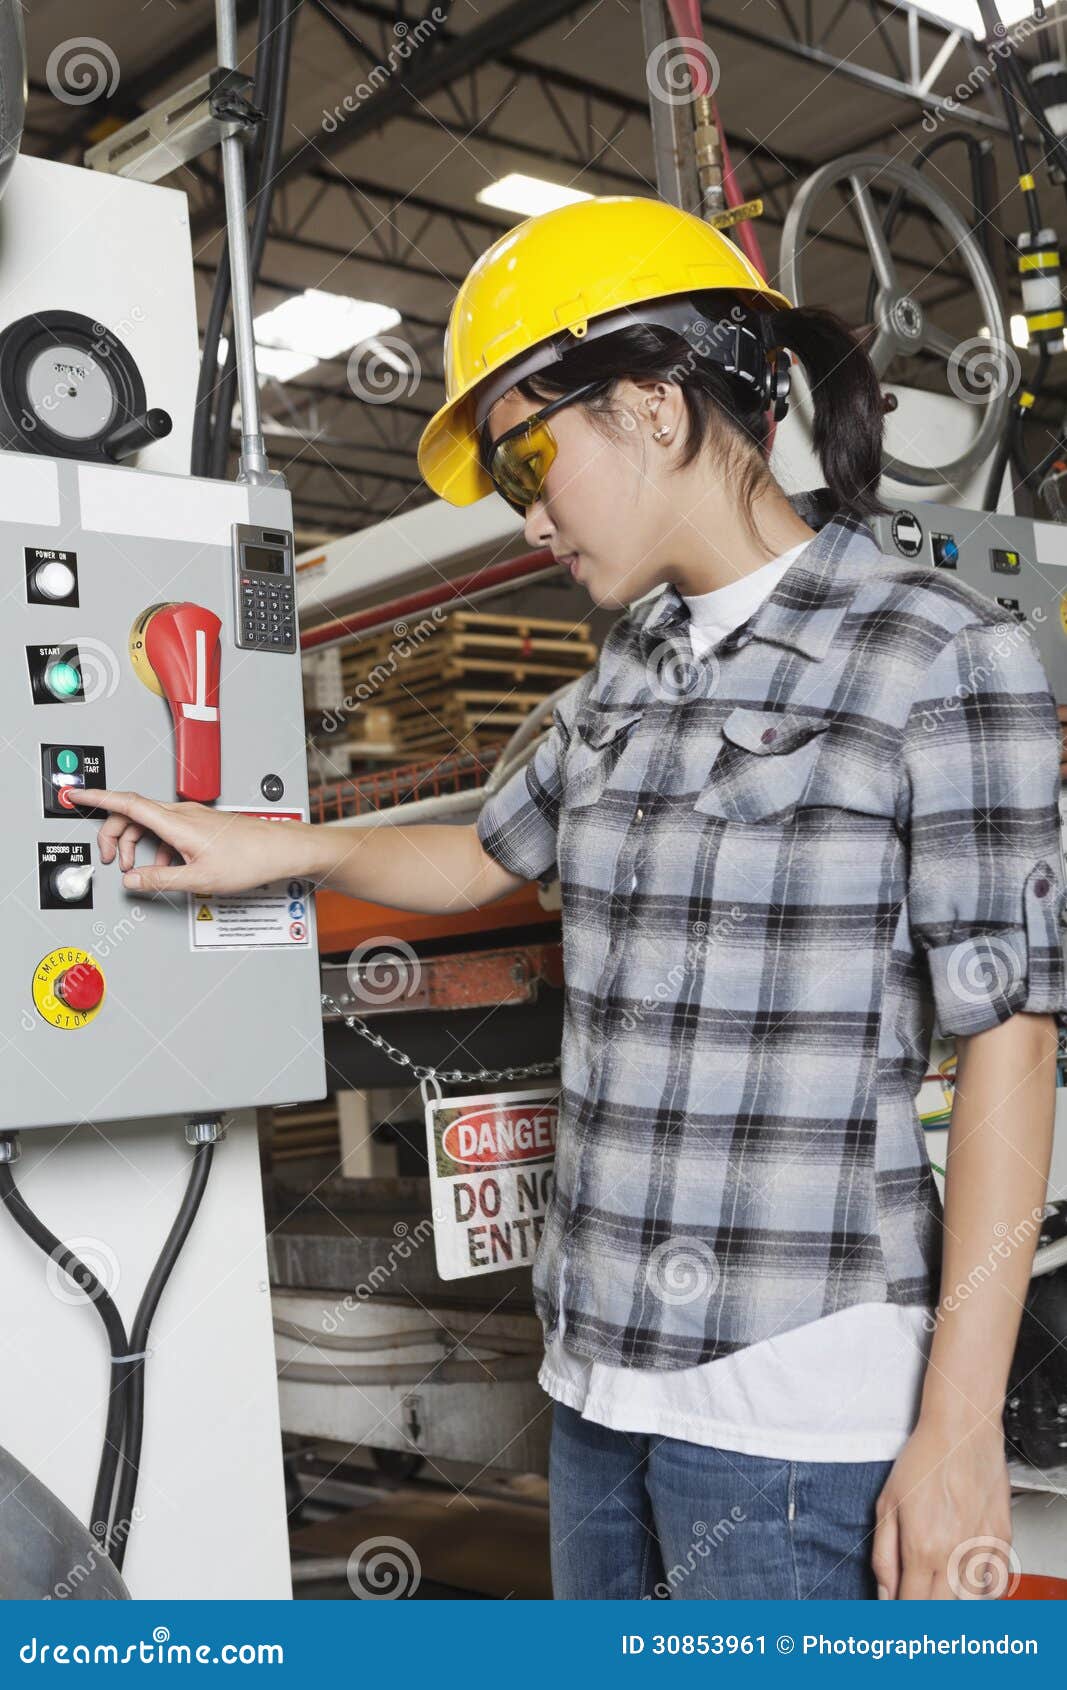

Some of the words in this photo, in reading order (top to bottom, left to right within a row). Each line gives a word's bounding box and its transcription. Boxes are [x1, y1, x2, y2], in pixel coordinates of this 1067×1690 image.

[35, 550, 56, 560] POWER
[59, 553, 67, 561] ON
[39, 648, 60, 656] START
[85, 766, 100, 774] TART
[46, 845, 70, 854] SCISSORS
[72, 846, 83, 854] LIFT
[42, 854, 57, 862] HAND
[70, 854, 84, 862] AUTO
[55, 1010, 88, 1027] STOP
[453, 1177, 501, 1223] DO
[516, 1169, 556, 1213] NO
